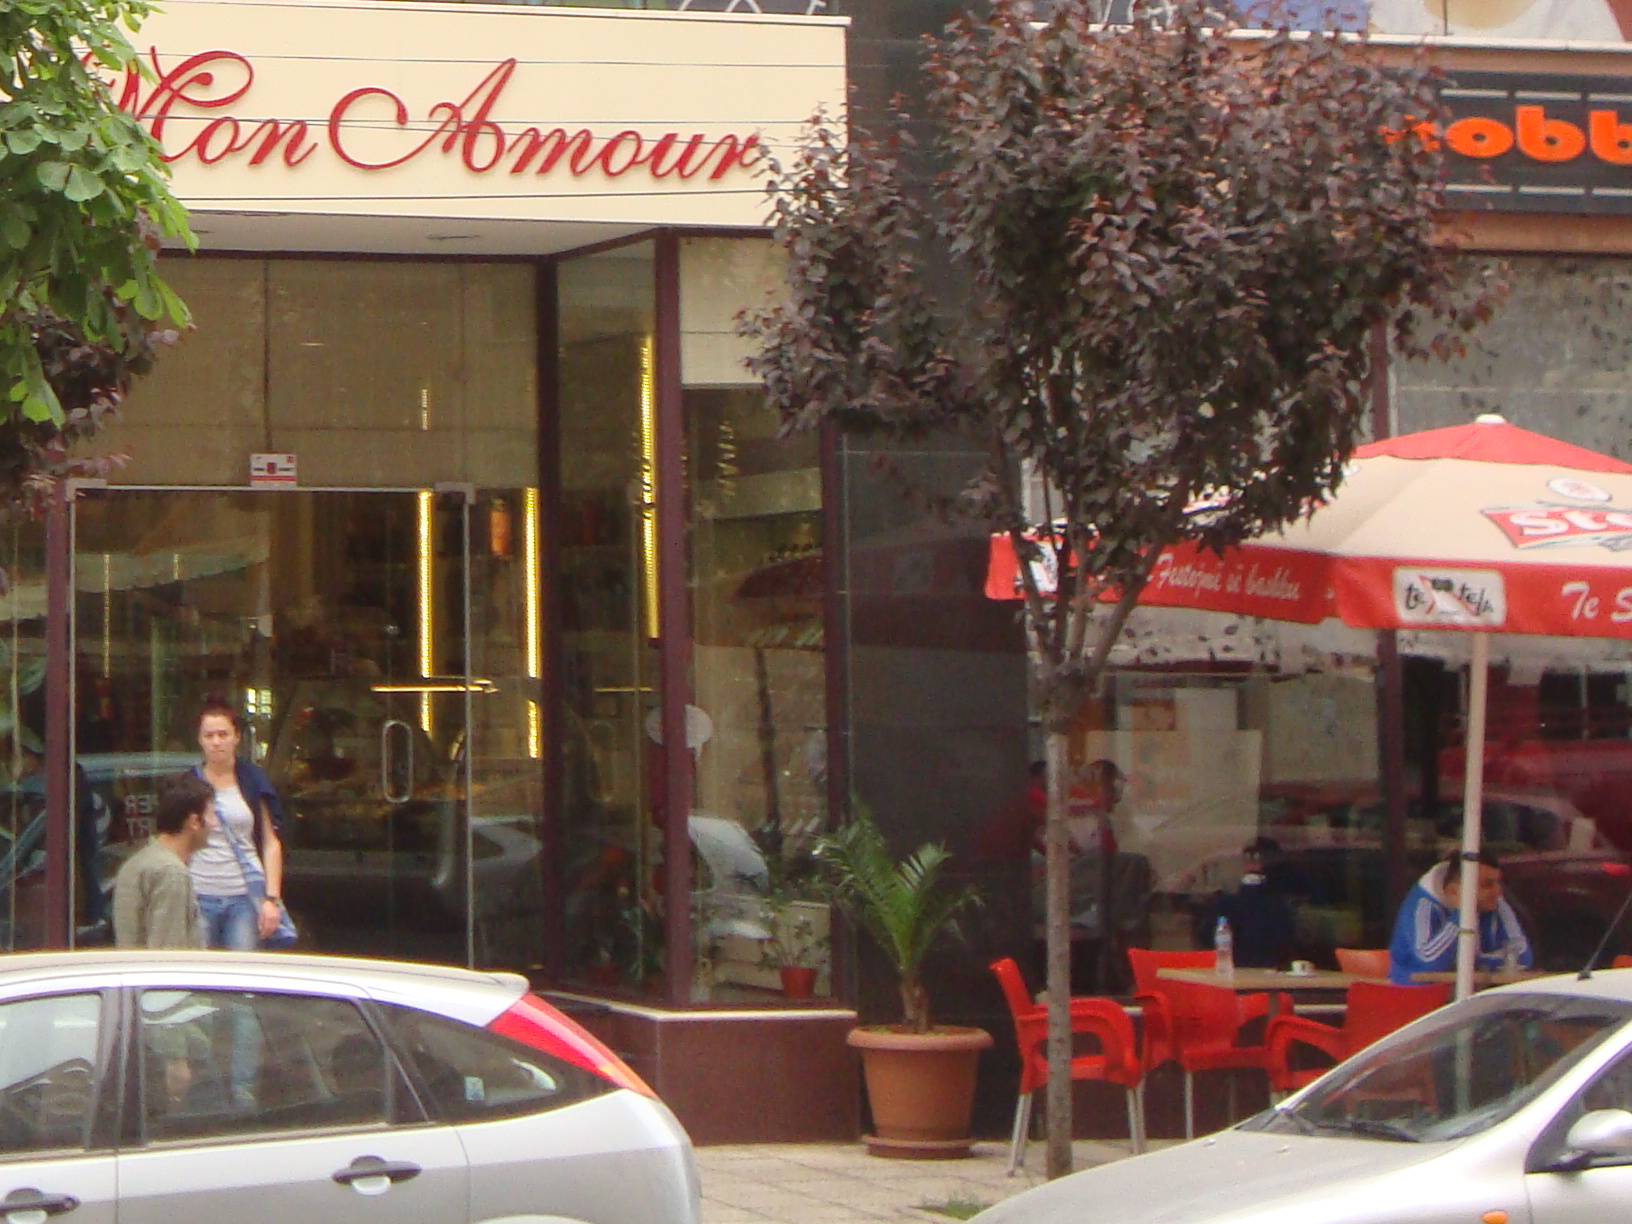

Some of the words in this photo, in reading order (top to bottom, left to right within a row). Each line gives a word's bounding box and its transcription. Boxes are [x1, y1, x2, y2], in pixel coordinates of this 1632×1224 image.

[327, 57, 764, 181] Amour
[1378, 105, 1632, 165] obb
[1561, 581, 1600, 621] Te
